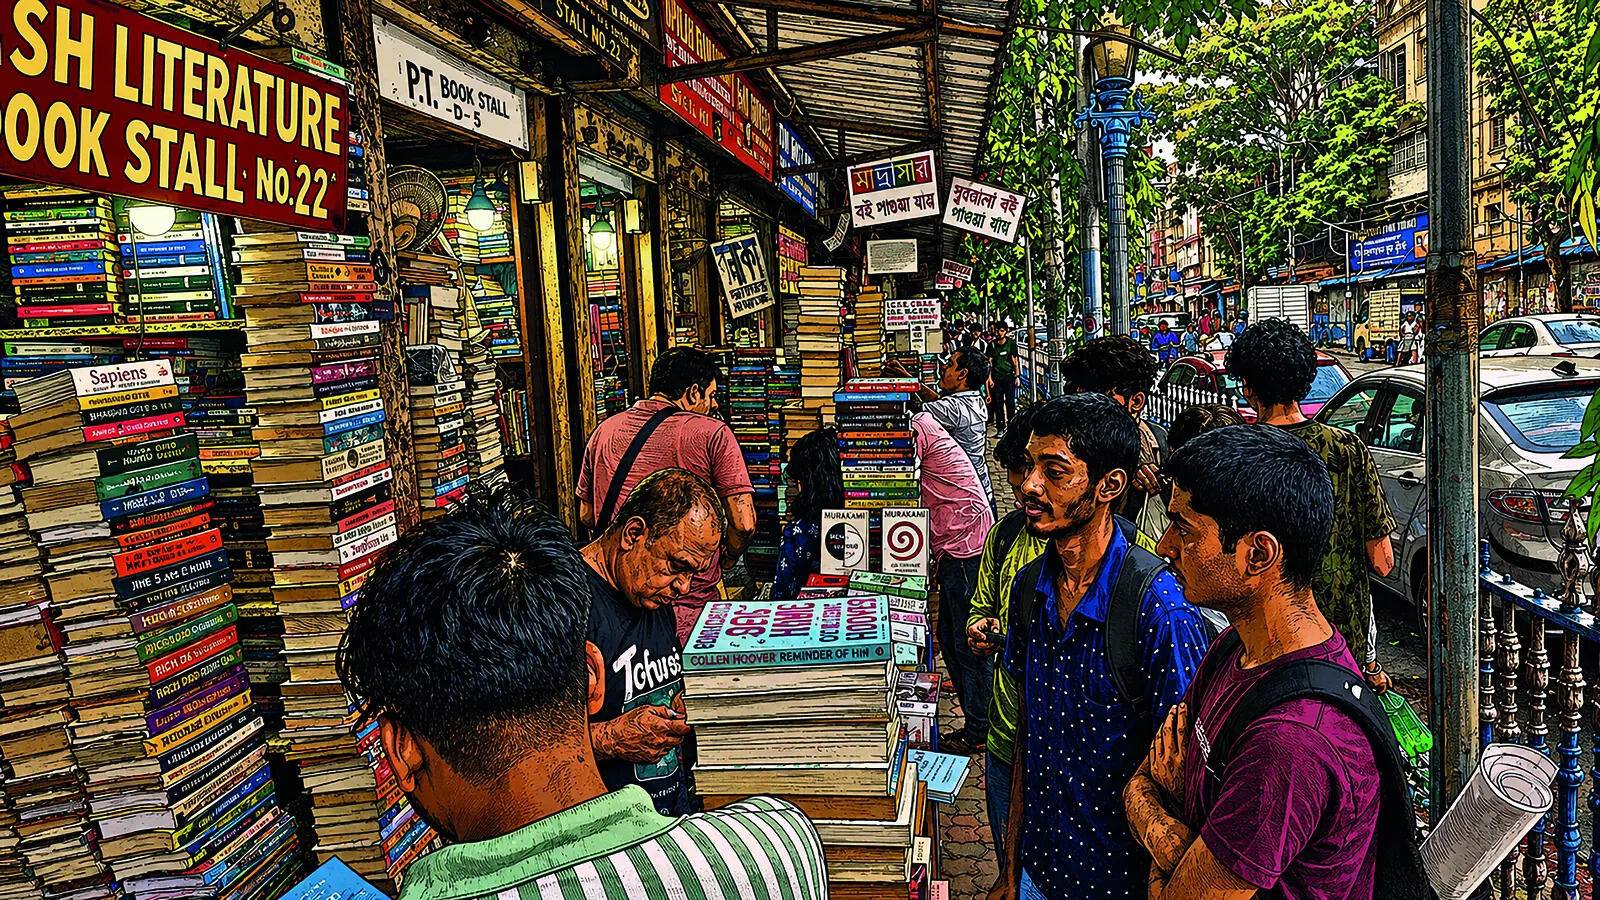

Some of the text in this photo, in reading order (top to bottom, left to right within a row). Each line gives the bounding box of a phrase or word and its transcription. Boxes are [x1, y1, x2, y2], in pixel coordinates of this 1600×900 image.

[556, 0, 588, 37] STALL
[114, 24, 341, 155] LITERATURE
[406, 60, 510, 119] P.T. BOOK STALL
[124, 119, 243, 203] STALL
[854, 199, 875, 220] বই
[1000, 195, 1019, 217] বই
[90, 367, 147, 387] Sapiens
[691, 654, 729, 666] COLLEN
[733, 653, 775, 664] HOOVER
[780, 649, 834, 662] REMINDER
[835, 647, 848, 659] OF
